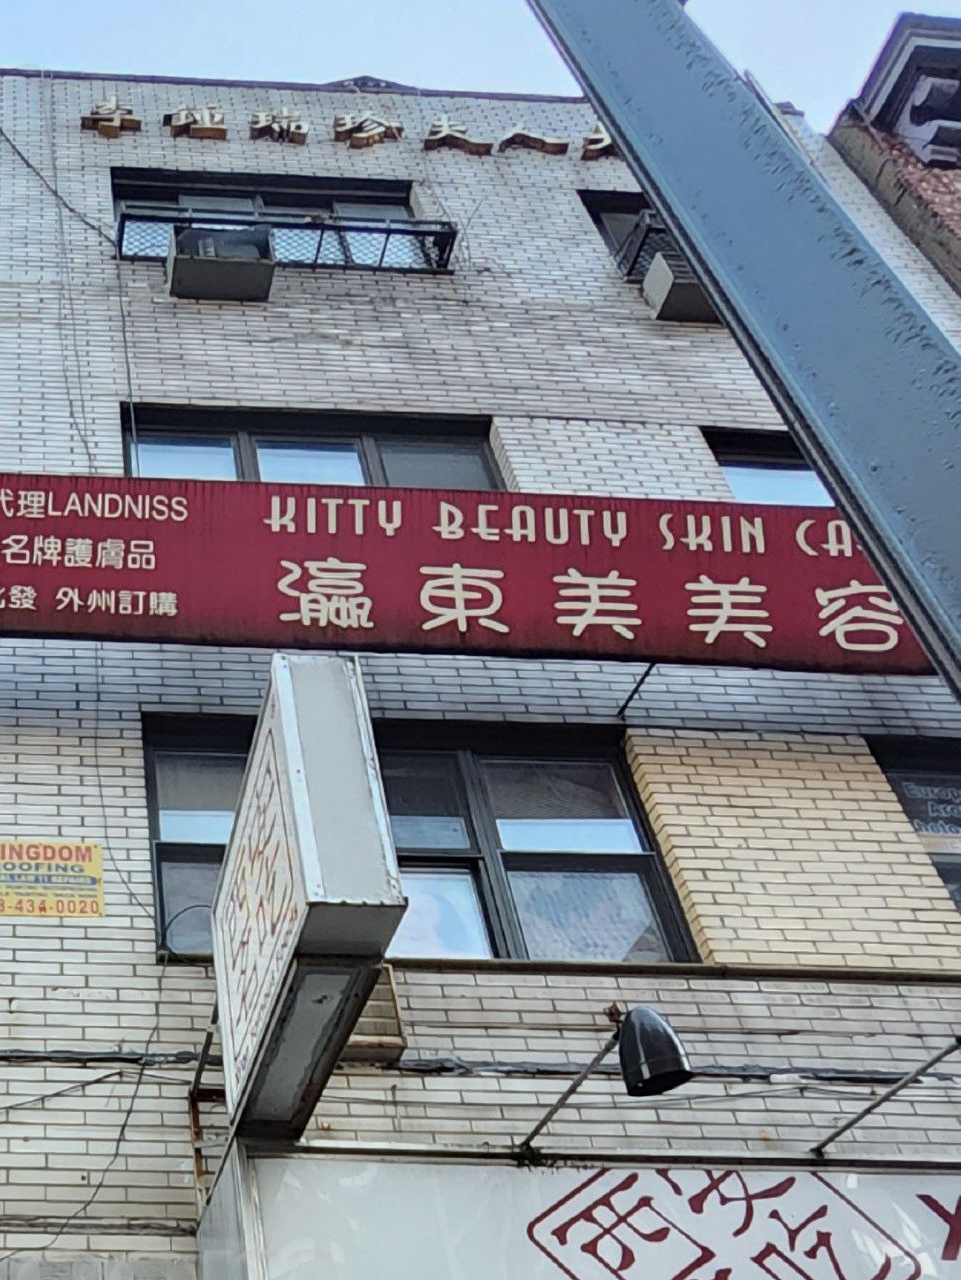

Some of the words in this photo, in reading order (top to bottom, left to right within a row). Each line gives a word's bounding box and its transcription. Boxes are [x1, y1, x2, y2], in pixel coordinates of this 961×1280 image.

[263, 495, 402, 538] KITTY
[432, 501, 628, 547] BEAUTY
[661, 512, 766, 554] SKIN
